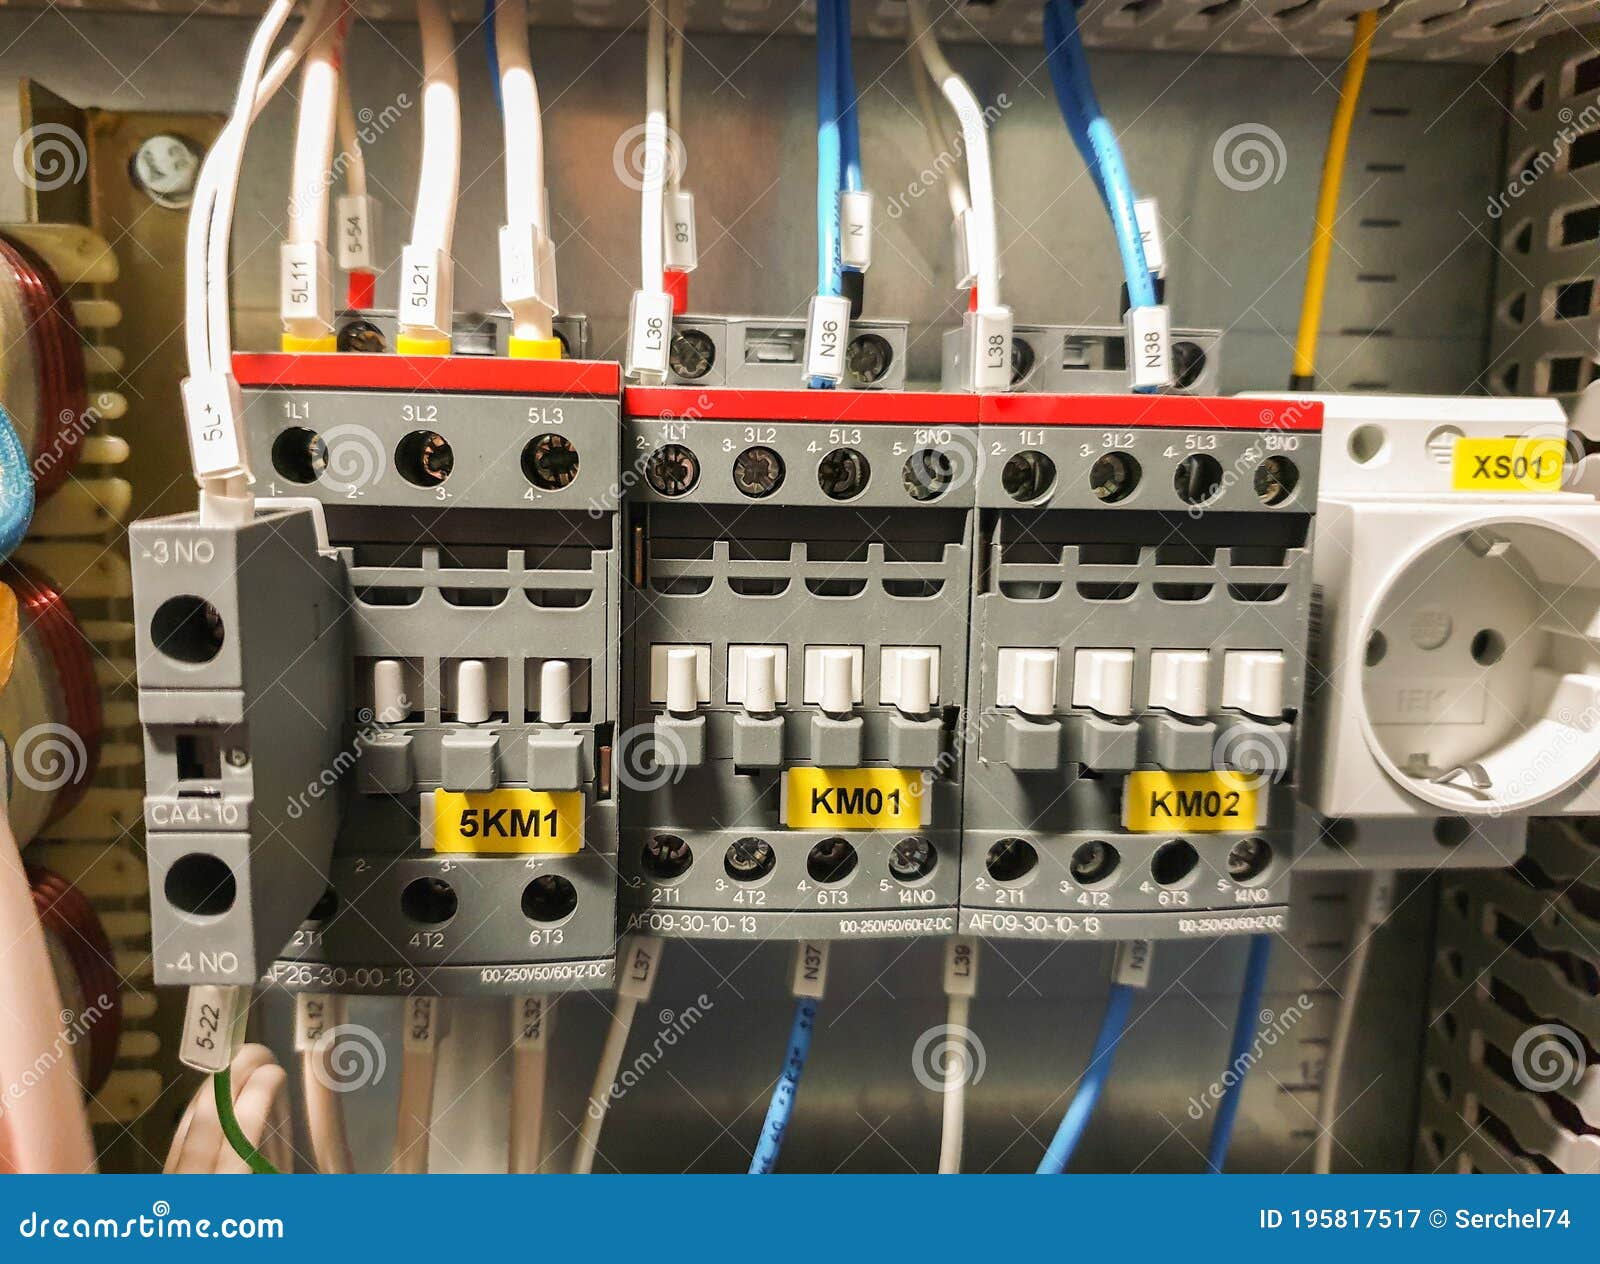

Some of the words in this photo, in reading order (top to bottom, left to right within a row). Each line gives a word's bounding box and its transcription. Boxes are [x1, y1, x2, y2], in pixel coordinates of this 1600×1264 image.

[349, 216, 363, 253] 5-54
[292, 261, 308, 303] 5L11
[412, 264, 429, 307] 5L21
[646, 317, 663, 350] L36
[820, 320, 838, 357] N36
[988, 334, 1004, 368] L38
[1144, 331, 1160, 368] N38
[284, 402, 310, 419] 1L1
[402, 405, 438, 422] 3L2
[528, 408, 564, 425] 5L3
[662, 427, 687, 441] 1L1
[744, 427, 776, 443] 3L2
[829, 429, 861, 444] 5L3
[1018, 431, 1044, 446] 1L1
[1102, 433, 1135, 448] 3L2
[1185, 434, 1217, 450] 5L3
[1472, 455, 1544, 479] XS01
[811, 787, 901, 815] KM01
[1150, 790, 1240, 817] KM02
[151, 803, 239, 825] CA4-10
[459, 808, 558, 838] 5KM1
[651, 888, 679, 903] 2T1
[733, 891, 766, 905] 4T2
[817, 890, 848, 905] 6T3
[898, 889, 936, 903] 14NO
[995, 890, 1023, 903] 2T1
[1076, 892, 1110, 907] 4T2
[1158, 890, 1189, 905] 6T3
[409, 932, 445, 948] 4T2
[529, 930, 564, 945] 6T3
[632, 948, 651, 982] L37
[804, 944, 822, 980] N37
[196, 1004, 220, 1050] 5-22
